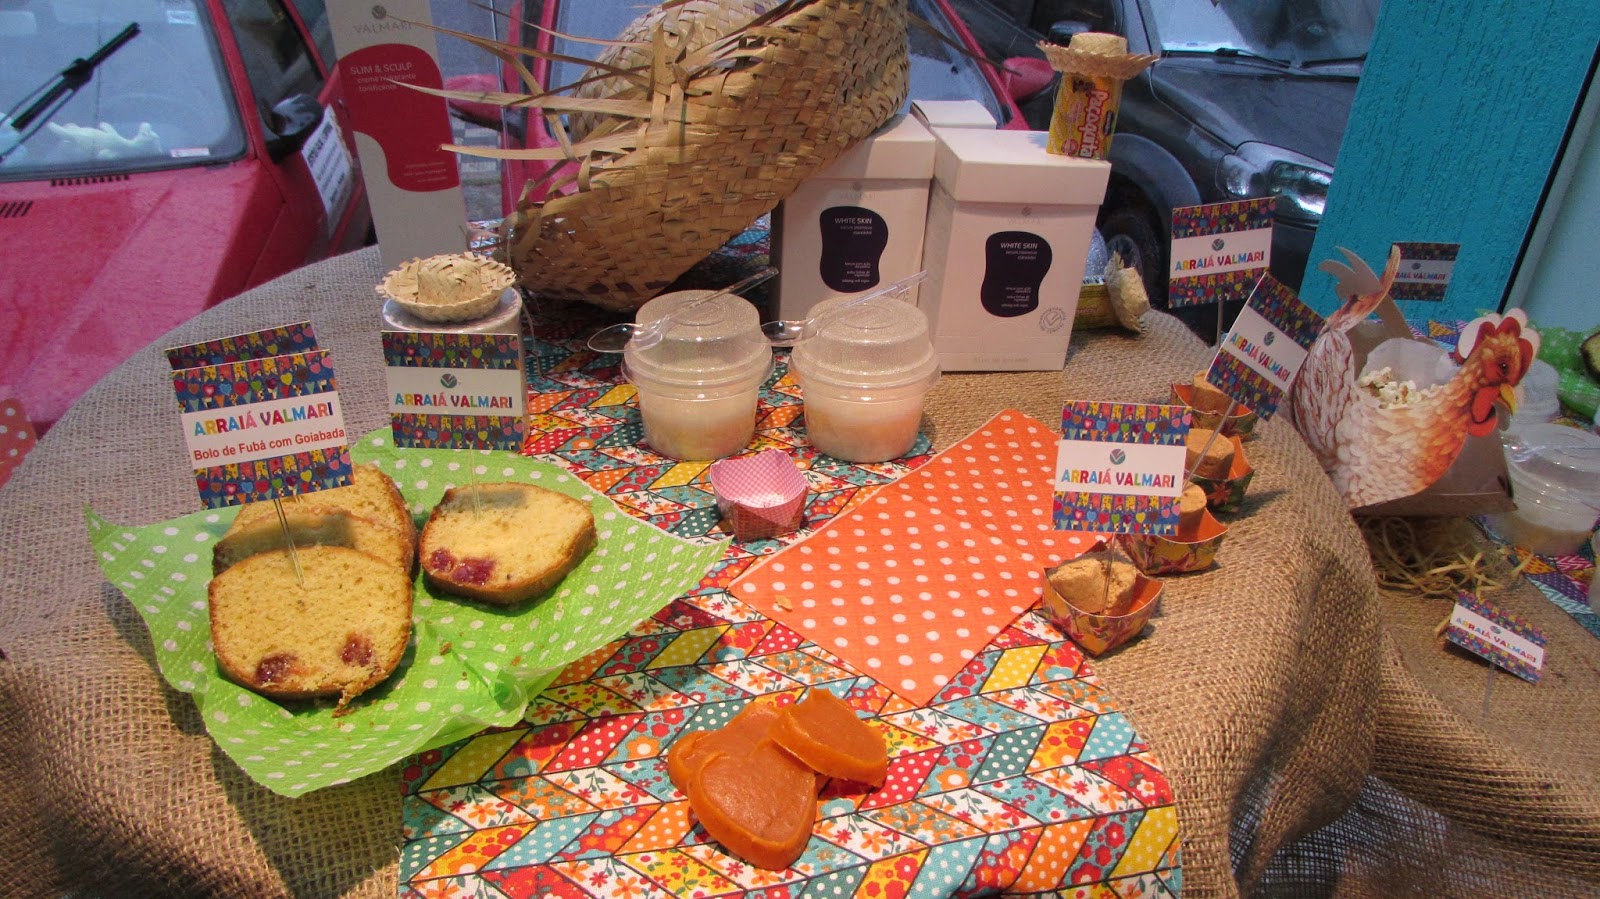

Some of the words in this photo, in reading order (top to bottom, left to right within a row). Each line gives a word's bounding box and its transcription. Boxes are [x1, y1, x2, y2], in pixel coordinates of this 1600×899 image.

[350, 65, 373, 76] SLIM
[375, 64, 383, 74] &
[384, 61, 414, 73] SCULP
[834, 217, 857, 225] WHITE
[857, 217, 873, 225] SKIN
[1000, 242, 1022, 250] WHITE
[1022, 242, 1039, 250] SKIN
[1175, 255, 1215, 271] ARRAIÁ
[1217, 251, 1265, 267] VALMARI
[1413, 272, 1446, 280] VALMARI
[1230, 332, 1261, 361] ARRAIÁ
[1258, 351, 1291, 382] VALMARI
[394, 391, 448, 407] ARRAIÁ
[450, 395, 513, 409] VALMARI
[194, 410, 258, 437] ARRAIÁ
[259, 401, 335, 427] VALMARI
[193, 448, 219, 461] Bolo
[222, 445, 237, 456] de
[239, 440, 267, 454] Fubá
[268, 438, 293, 449] com
[294, 427, 346, 444] Goiabada
[1061, 468, 1112, 485] ARRAIÁ
[1116, 472, 1176, 489] VALMARI
[1493, 636, 1537, 663] VALMARI
